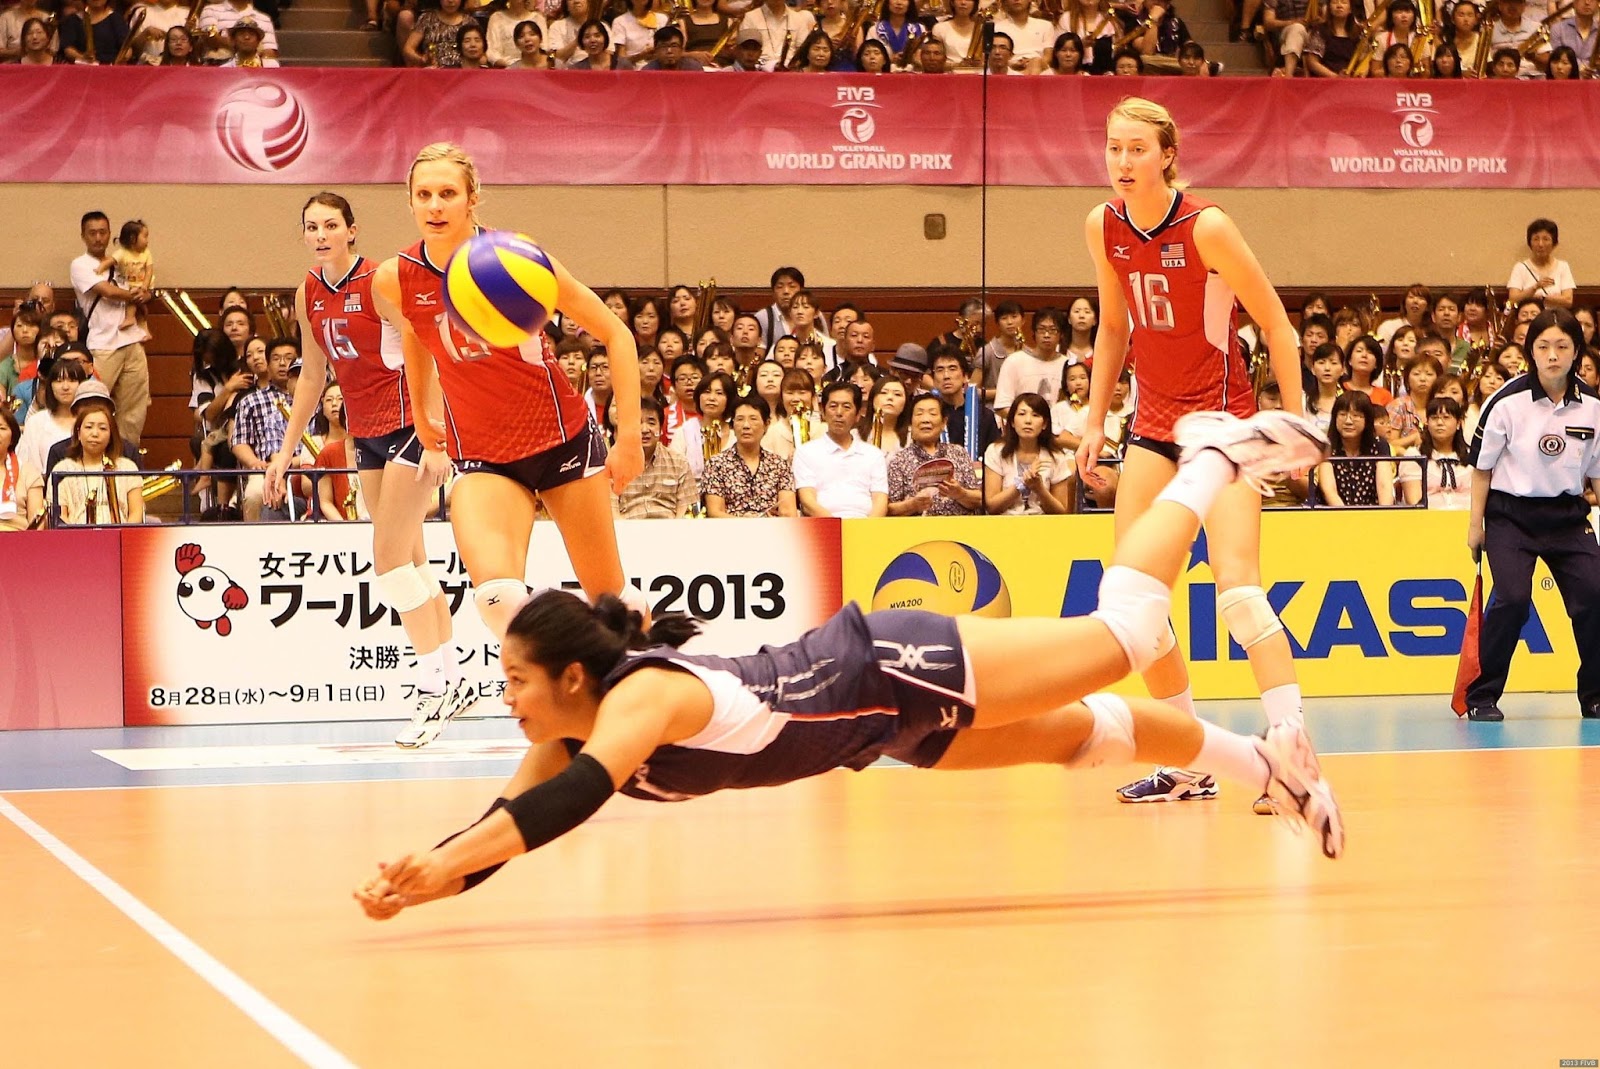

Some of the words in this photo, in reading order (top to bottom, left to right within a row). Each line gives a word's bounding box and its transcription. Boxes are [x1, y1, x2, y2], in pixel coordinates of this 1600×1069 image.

[837, 86, 875, 101] FIVB
[1396, 92, 1433, 107] FIVB
[766, 153, 835, 169] WORLD
[839, 153, 905, 169] GRAND
[910, 153, 952, 169] PRIX
[1330, 157, 1395, 173] WORLD
[1400, 157, 1462, 173] GRAND
[1466, 157, 1507, 173] PRIX
[1128, 271, 1175, 331] 16
[321, 318, 359, 361] 15
[890, 597, 923, 609] MVA200
[349, 643, 501, 670] 決勝ランド
